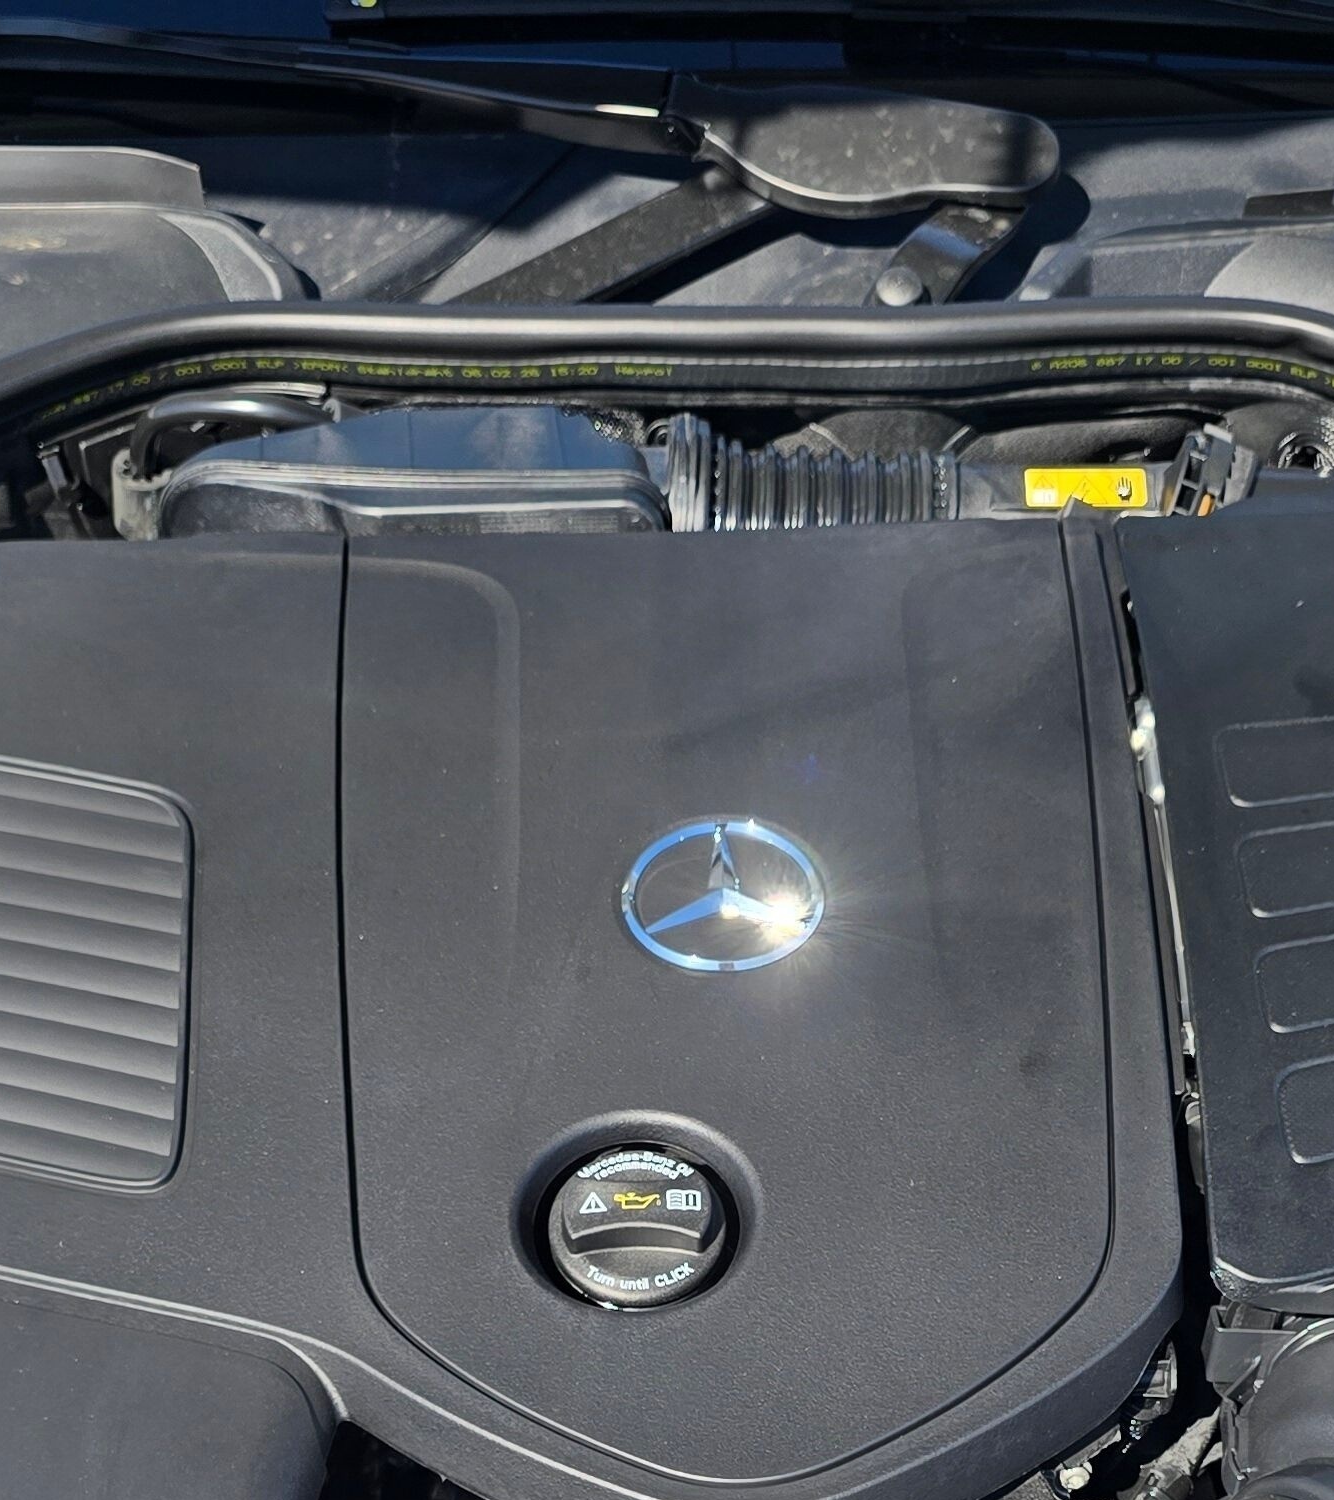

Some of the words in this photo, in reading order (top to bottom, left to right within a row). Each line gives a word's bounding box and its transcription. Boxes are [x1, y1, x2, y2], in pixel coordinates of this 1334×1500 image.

[577, 1151, 676, 1179] Mercedes-Benz
[676, 1162, 695, 1178] Oil
[593, 1160, 680, 1181] recommended
[587, 1264, 616, 1288] Turn
[619, 1277, 650, 1291] until
[654, 1261, 695, 1288] CLICK
